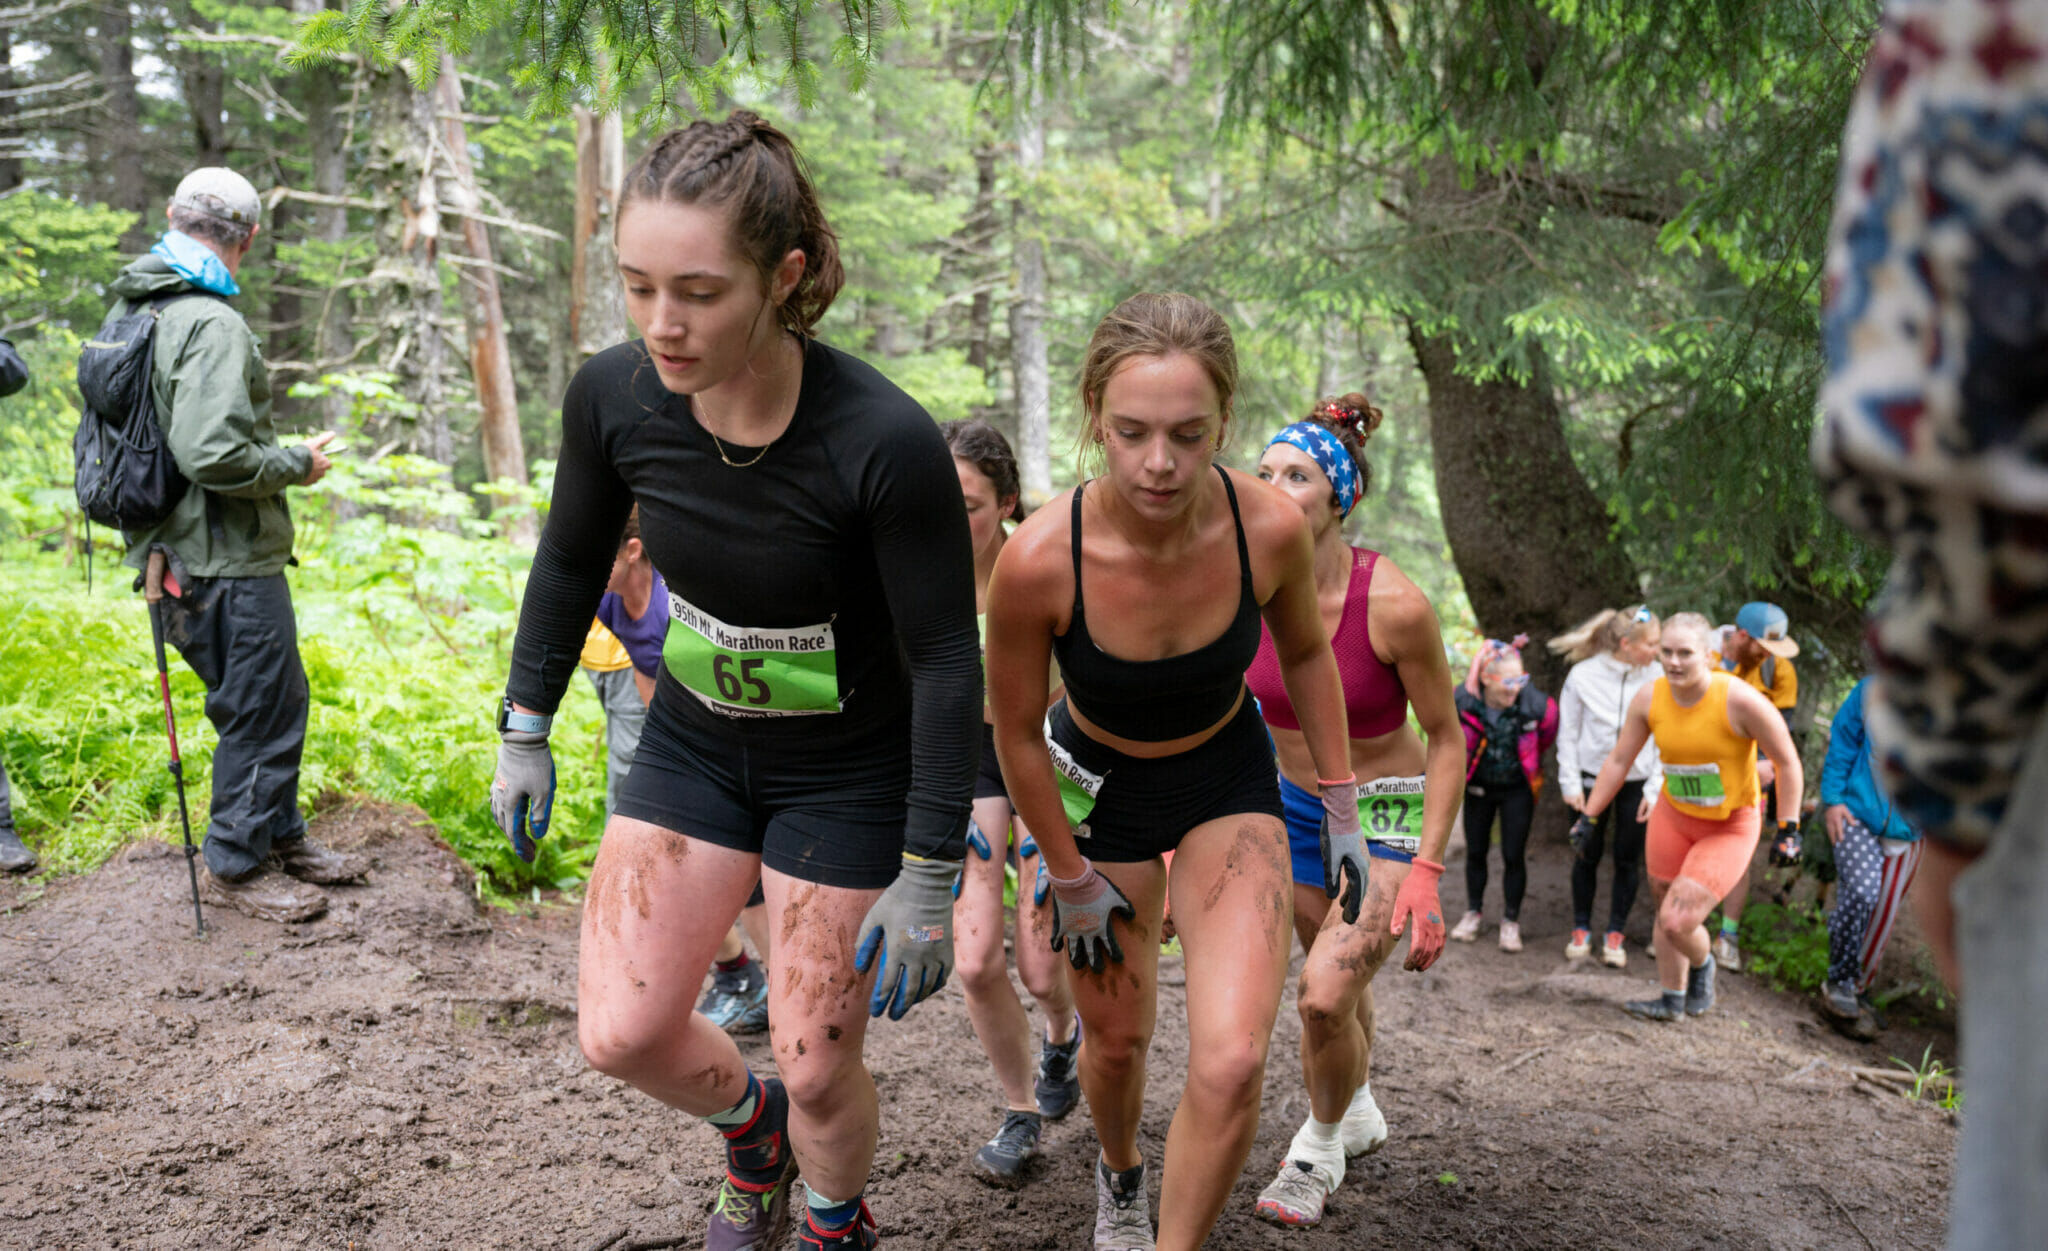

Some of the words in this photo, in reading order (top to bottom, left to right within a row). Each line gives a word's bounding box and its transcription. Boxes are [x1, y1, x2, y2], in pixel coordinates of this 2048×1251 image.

[674, 602, 697, 628] 95th
[699, 618, 713, 640] Mt.
[716, 628, 784, 650] Marathon
[789, 636, 825, 650] Race
[713, 654, 772, 705] 65
[1068, 765, 1094, 792] Race
[1358, 785, 1374, 796] Mt.
[1376, 781, 1420, 792] Marathon
[1371, 798, 1410, 833] 82
